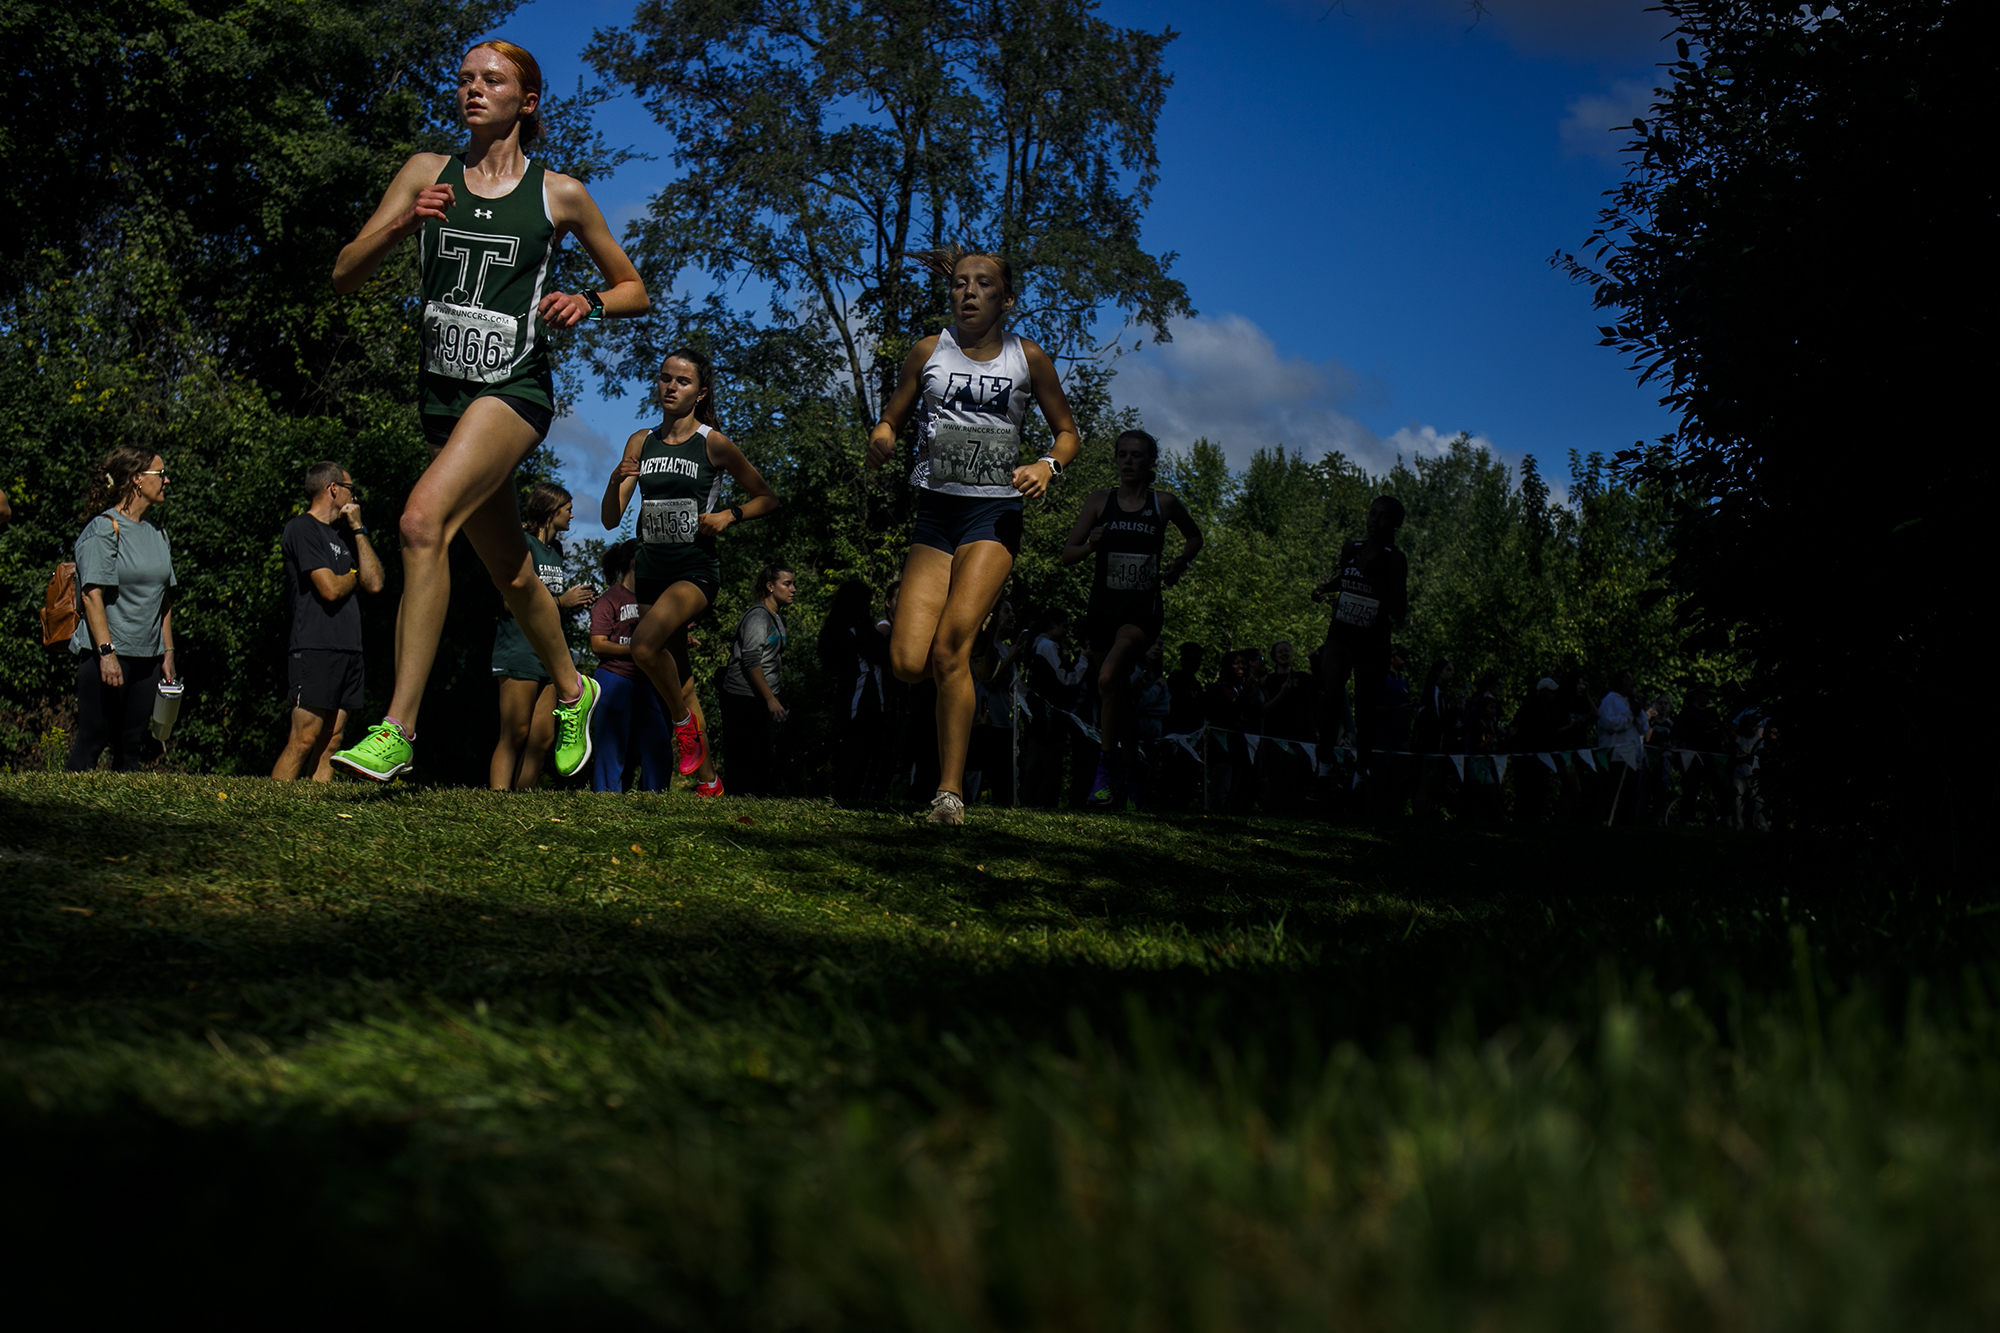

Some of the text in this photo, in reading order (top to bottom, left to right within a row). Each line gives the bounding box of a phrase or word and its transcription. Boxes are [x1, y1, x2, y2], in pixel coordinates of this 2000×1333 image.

[438, 227, 520, 309] T
[432, 321, 503, 370] 1966
[942, 373, 1012, 416] AH
[943, 423, 1012, 435] WWW.RUNCCRS.COM
[967, 439, 983, 471] 7
[639, 456, 699, 479] METHACTON
[646, 511, 691, 534] 1153
[1120, 563, 1148, 583] 198
[1344, 566, 1363, 578] STA
[1341, 578, 1374, 594] OLLEG
[1343, 601, 1373, 622] 1775
